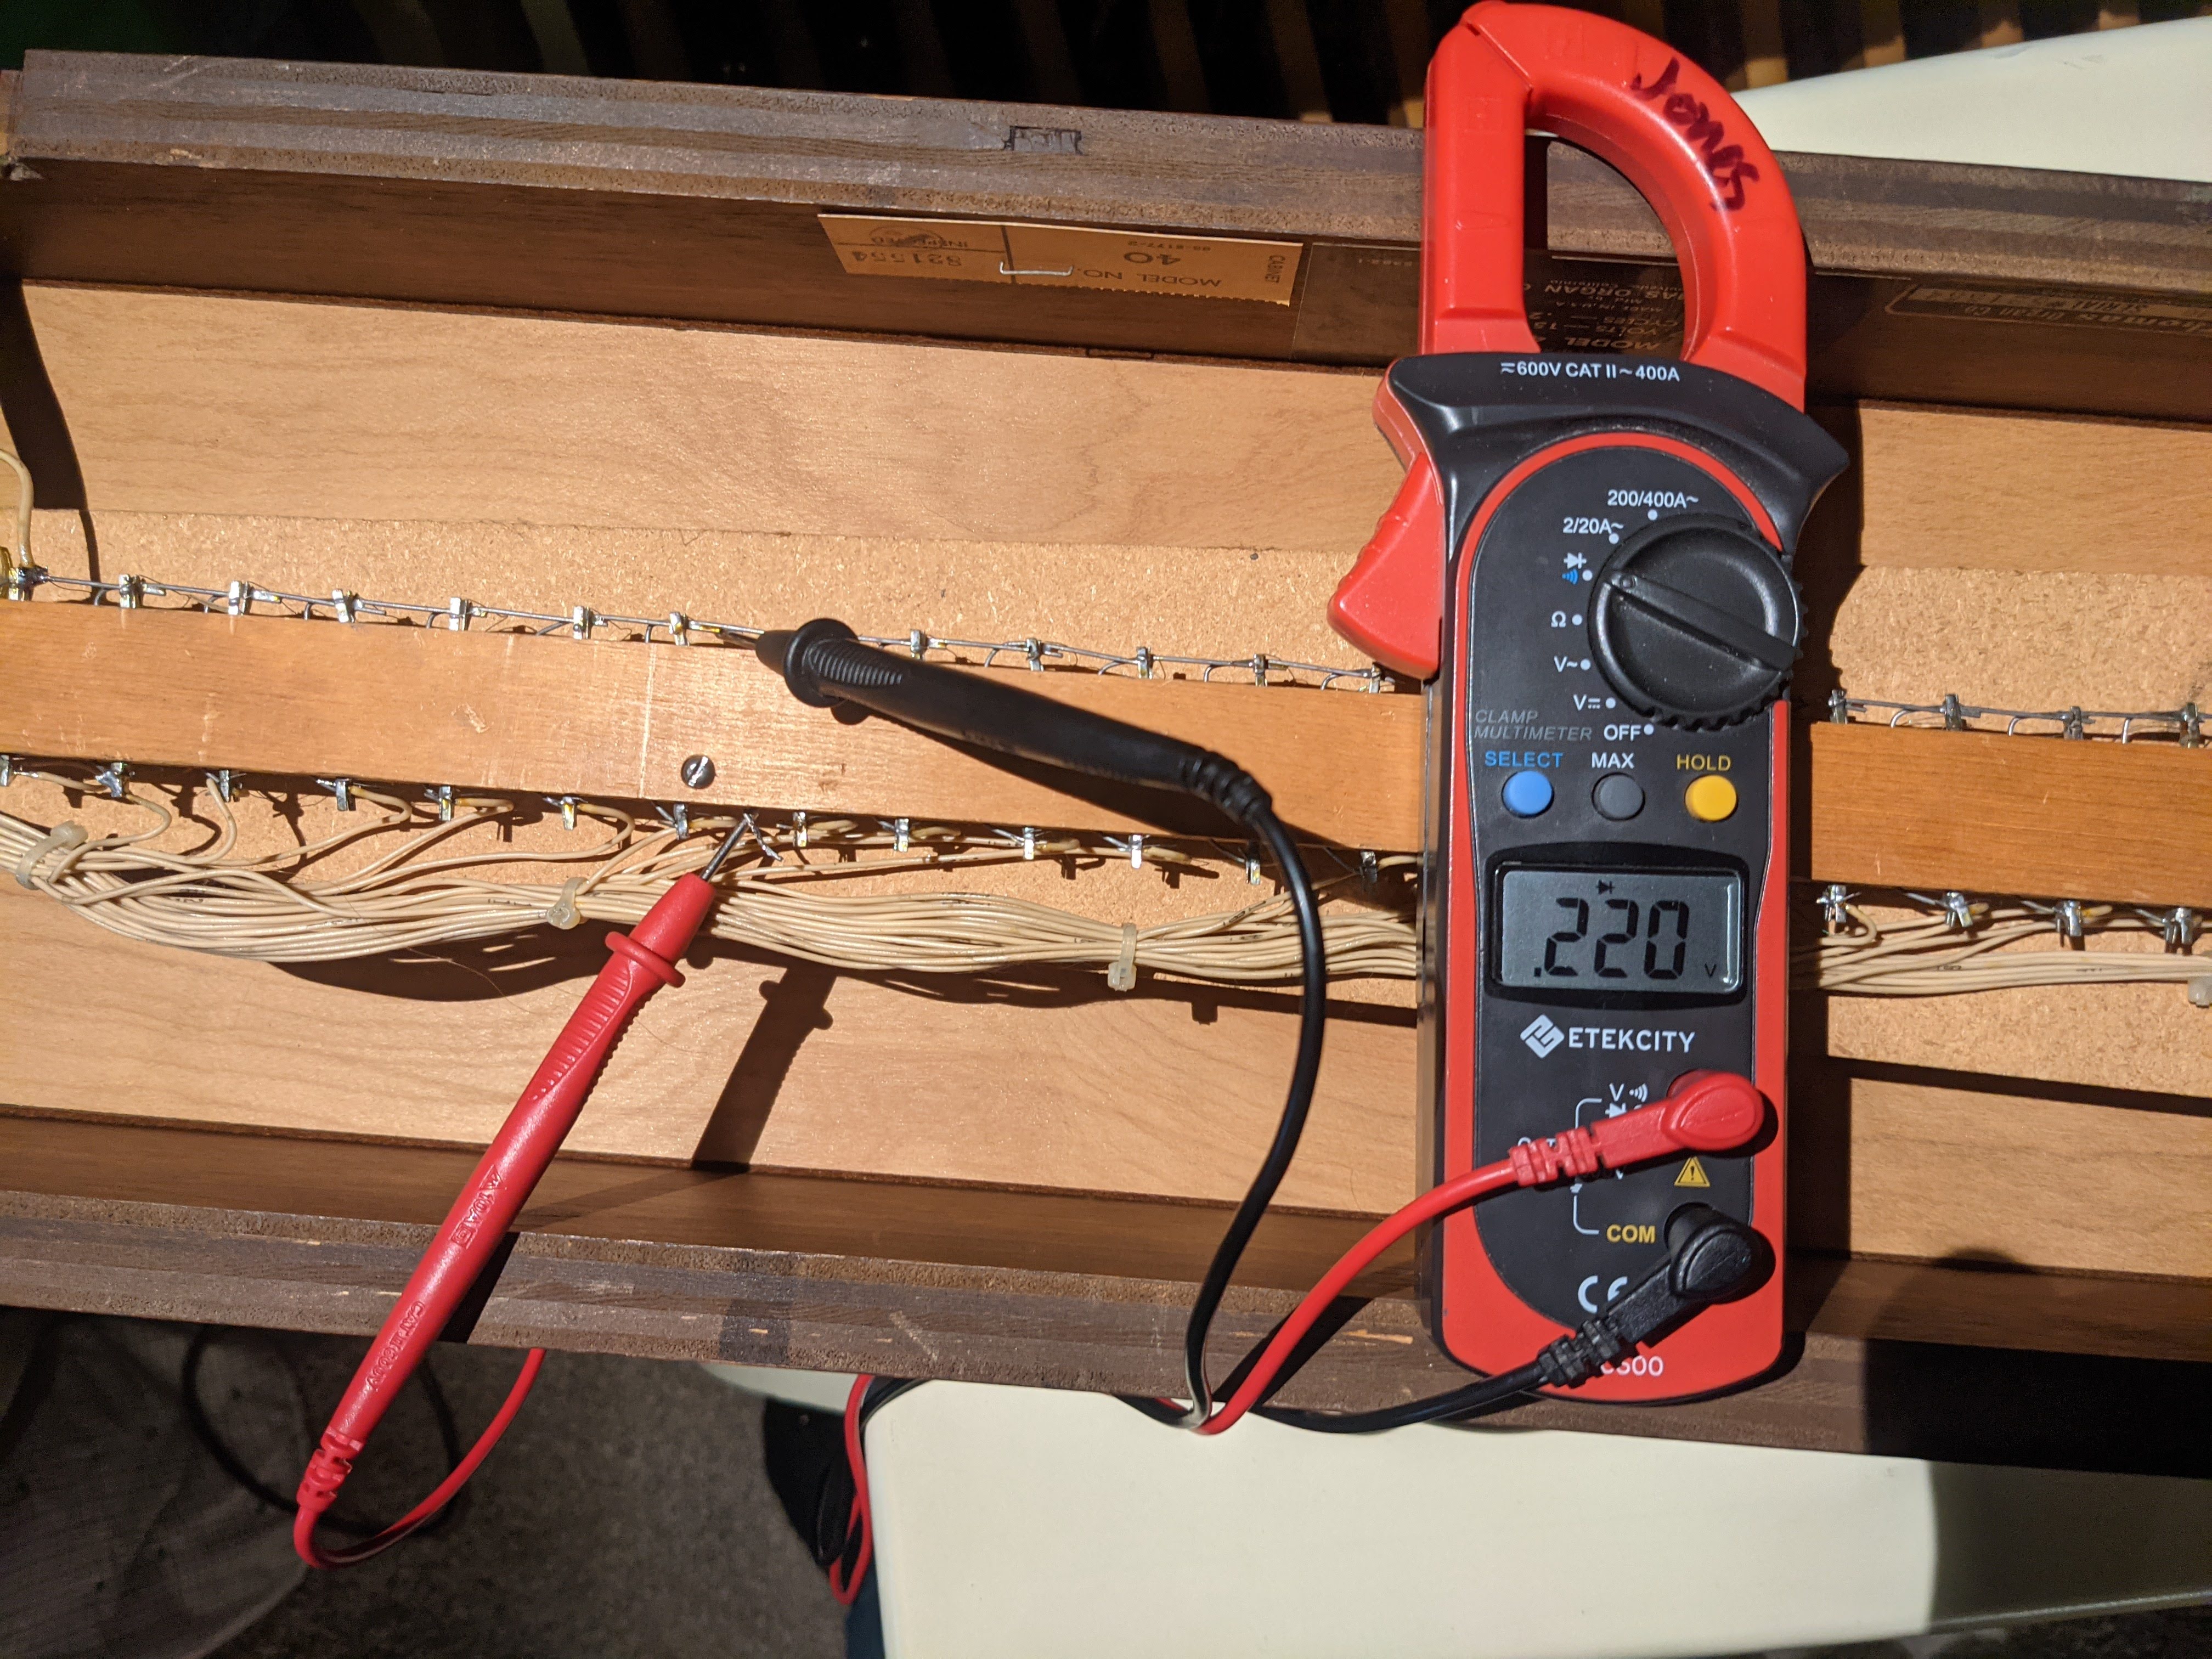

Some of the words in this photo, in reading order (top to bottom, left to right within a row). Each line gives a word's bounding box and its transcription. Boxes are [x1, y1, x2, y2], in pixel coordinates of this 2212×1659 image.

[1124, 251, 1181, 266] 40
[1077, 268, 1122, 280] NO.
[1137, 273, 1222, 287] MODEL
[1565, 336, 1661, 350] MODEL
[1565, 362, 1602, 379] CAT
[1606, 364, 1616, 379] II
[1475, 709, 1538, 724] CLAMP
[1474, 725, 1593, 741] MULTIMETER
[1604, 724, 1640, 741] OFF
[1485, 750, 1563, 768] SELECT
[1591, 753, 1635, 769] MAX
[1677, 754, 1731, 770] HOLD
[1568, 1027, 1695, 1053] ETEKCITY
[1606, 1224, 1656, 1244] COM
